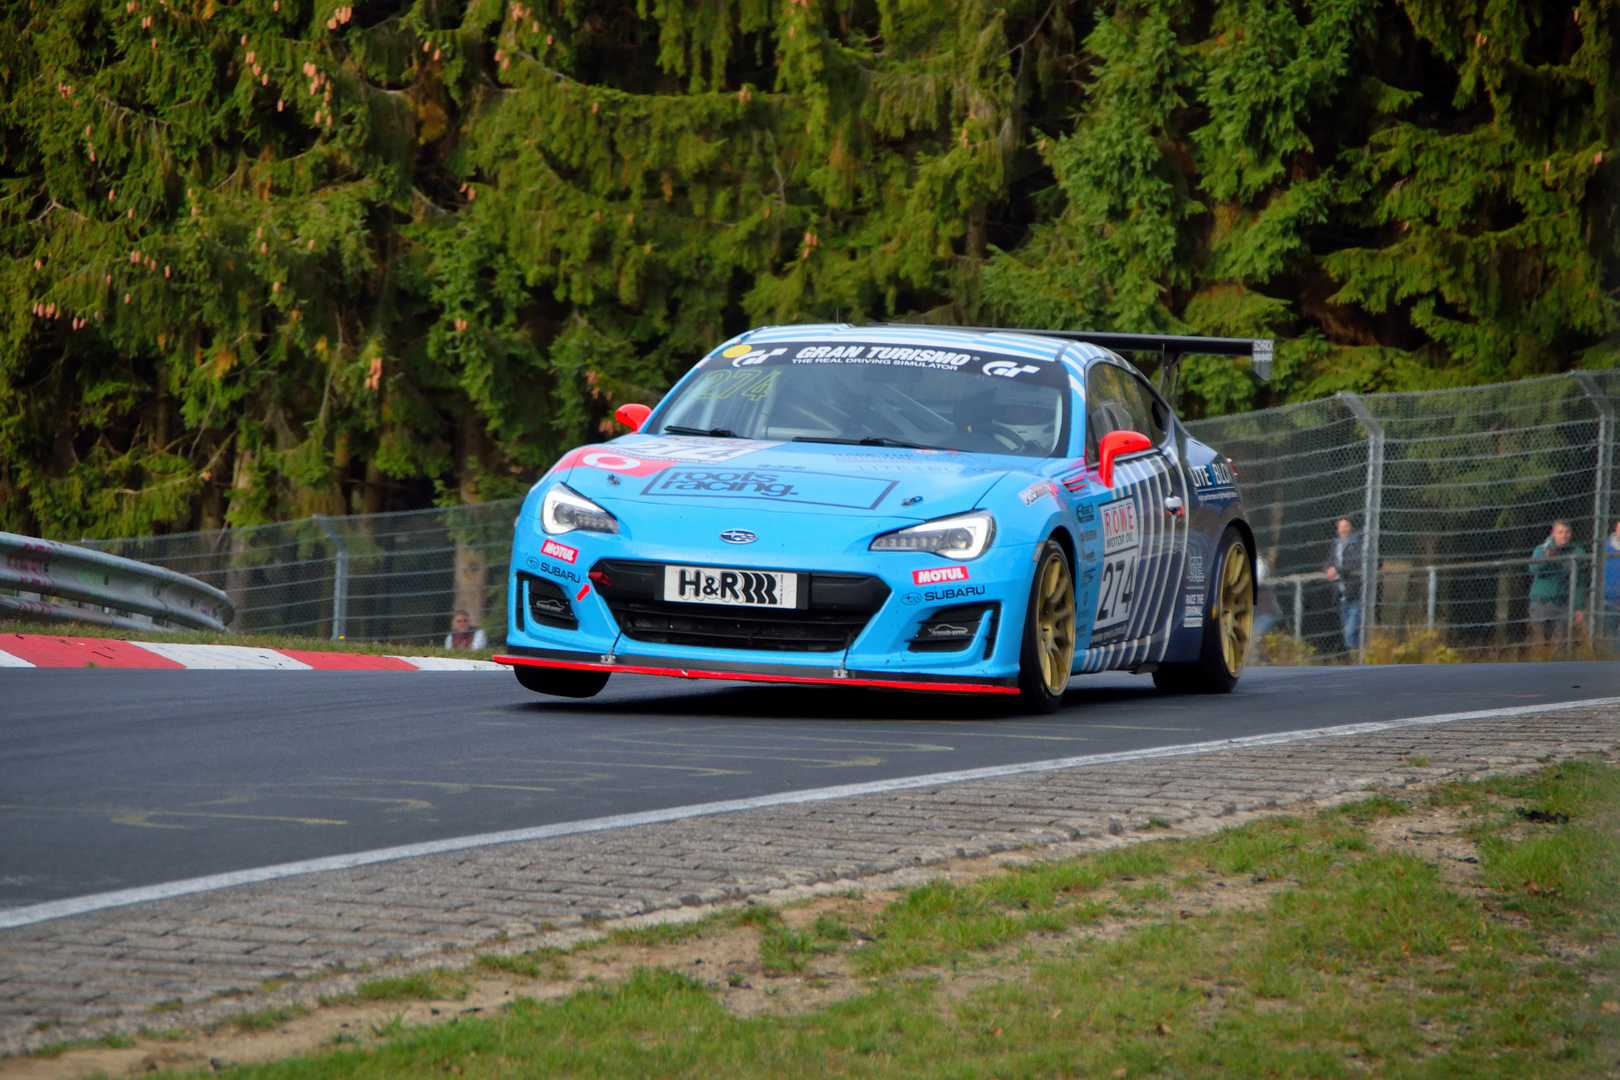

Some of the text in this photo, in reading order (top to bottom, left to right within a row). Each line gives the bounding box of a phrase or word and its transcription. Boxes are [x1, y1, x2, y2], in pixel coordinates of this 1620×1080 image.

[795, 346, 867, 359] GRAN
[892, 359, 959, 371] SIMULATOR
[689, 369, 781, 401] 274
[669, 471, 780, 483] roots
[1104, 505, 1134, 537] ROWE
[1106, 535, 1125, 549] MOTOR
[1126, 533, 1135, 545] OIL
[543, 541, 575, 561] MOTUL
[540, 562, 581, 584] SUBARU
[918, 567, 965, 584] MOTUL
[925, 585, 986, 601] SUBARU
[1097, 555, 1136, 621] 274
